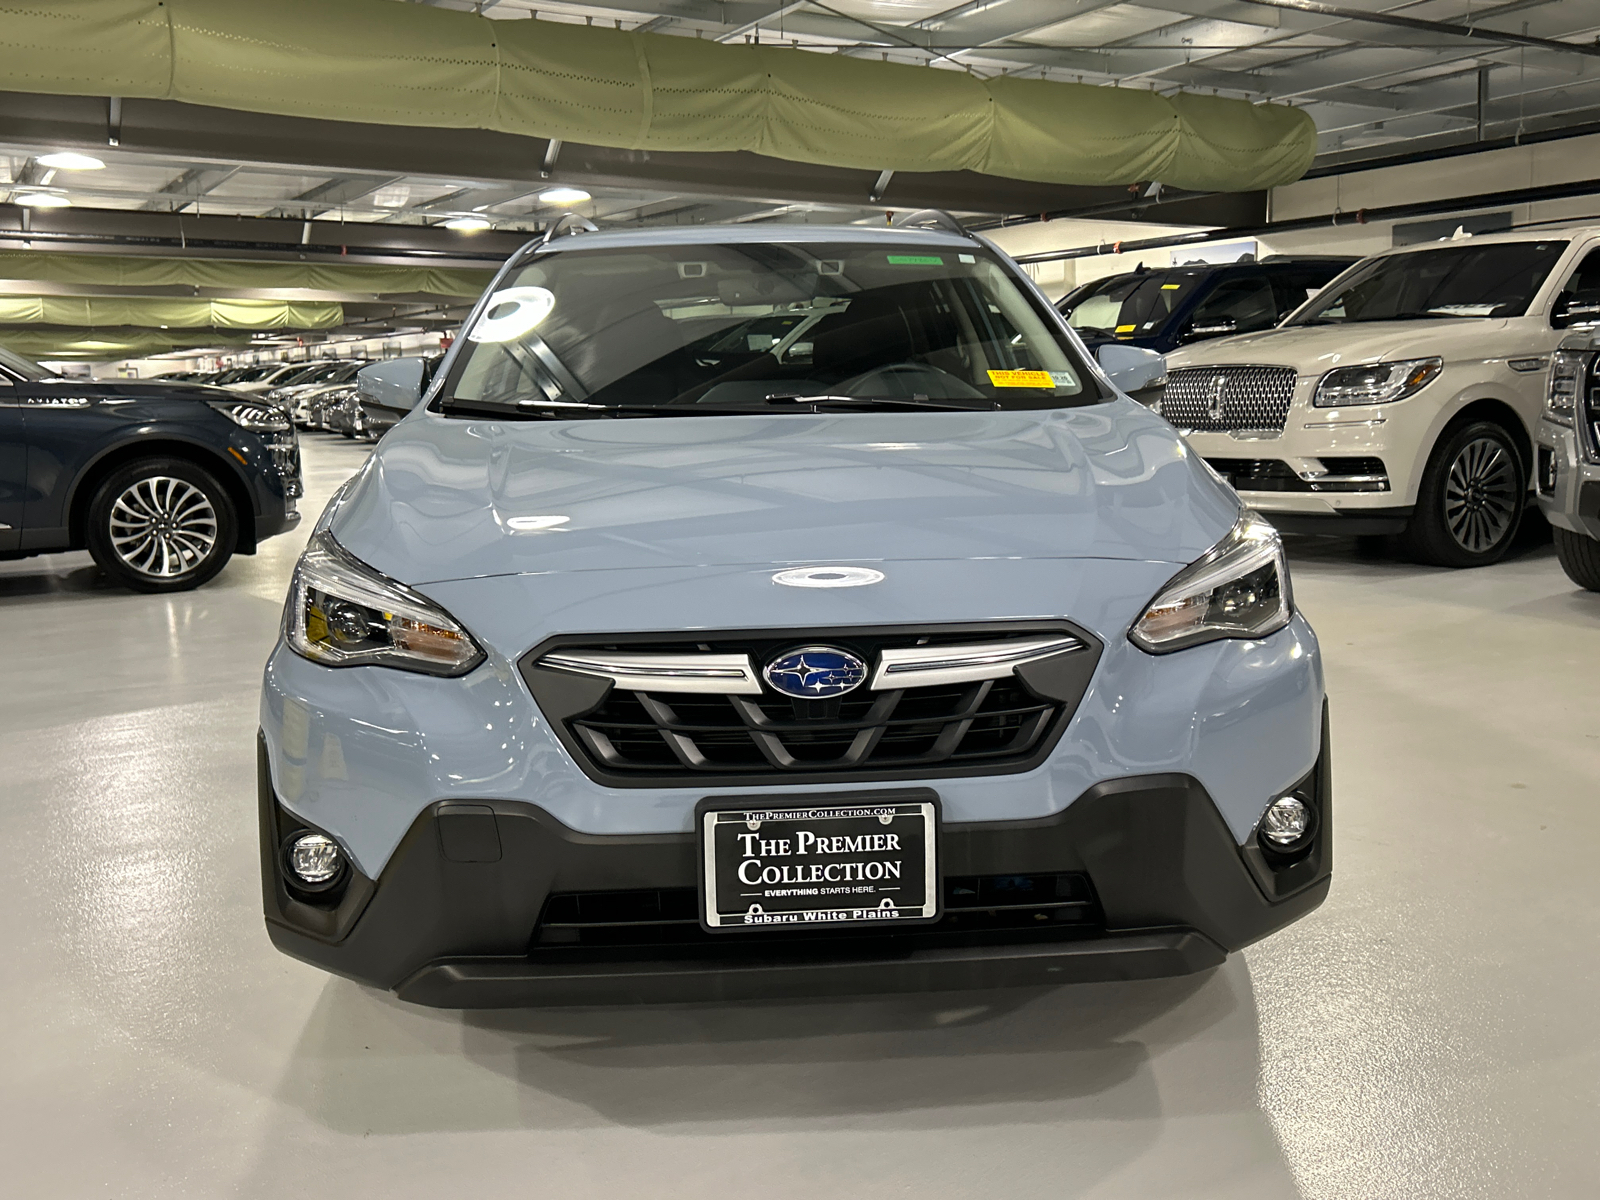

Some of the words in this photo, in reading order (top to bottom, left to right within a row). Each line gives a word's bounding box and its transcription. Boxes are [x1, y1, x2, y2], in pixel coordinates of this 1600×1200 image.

[764, 888, 818, 897] EVERYTHING
[820, 887, 850, 895] STARTS
[852, 886, 876, 894] HERE.
[744, 914, 798, 924] Subaru
[803, 911, 847, 921] White
[853, 909, 900, 919] Plains
